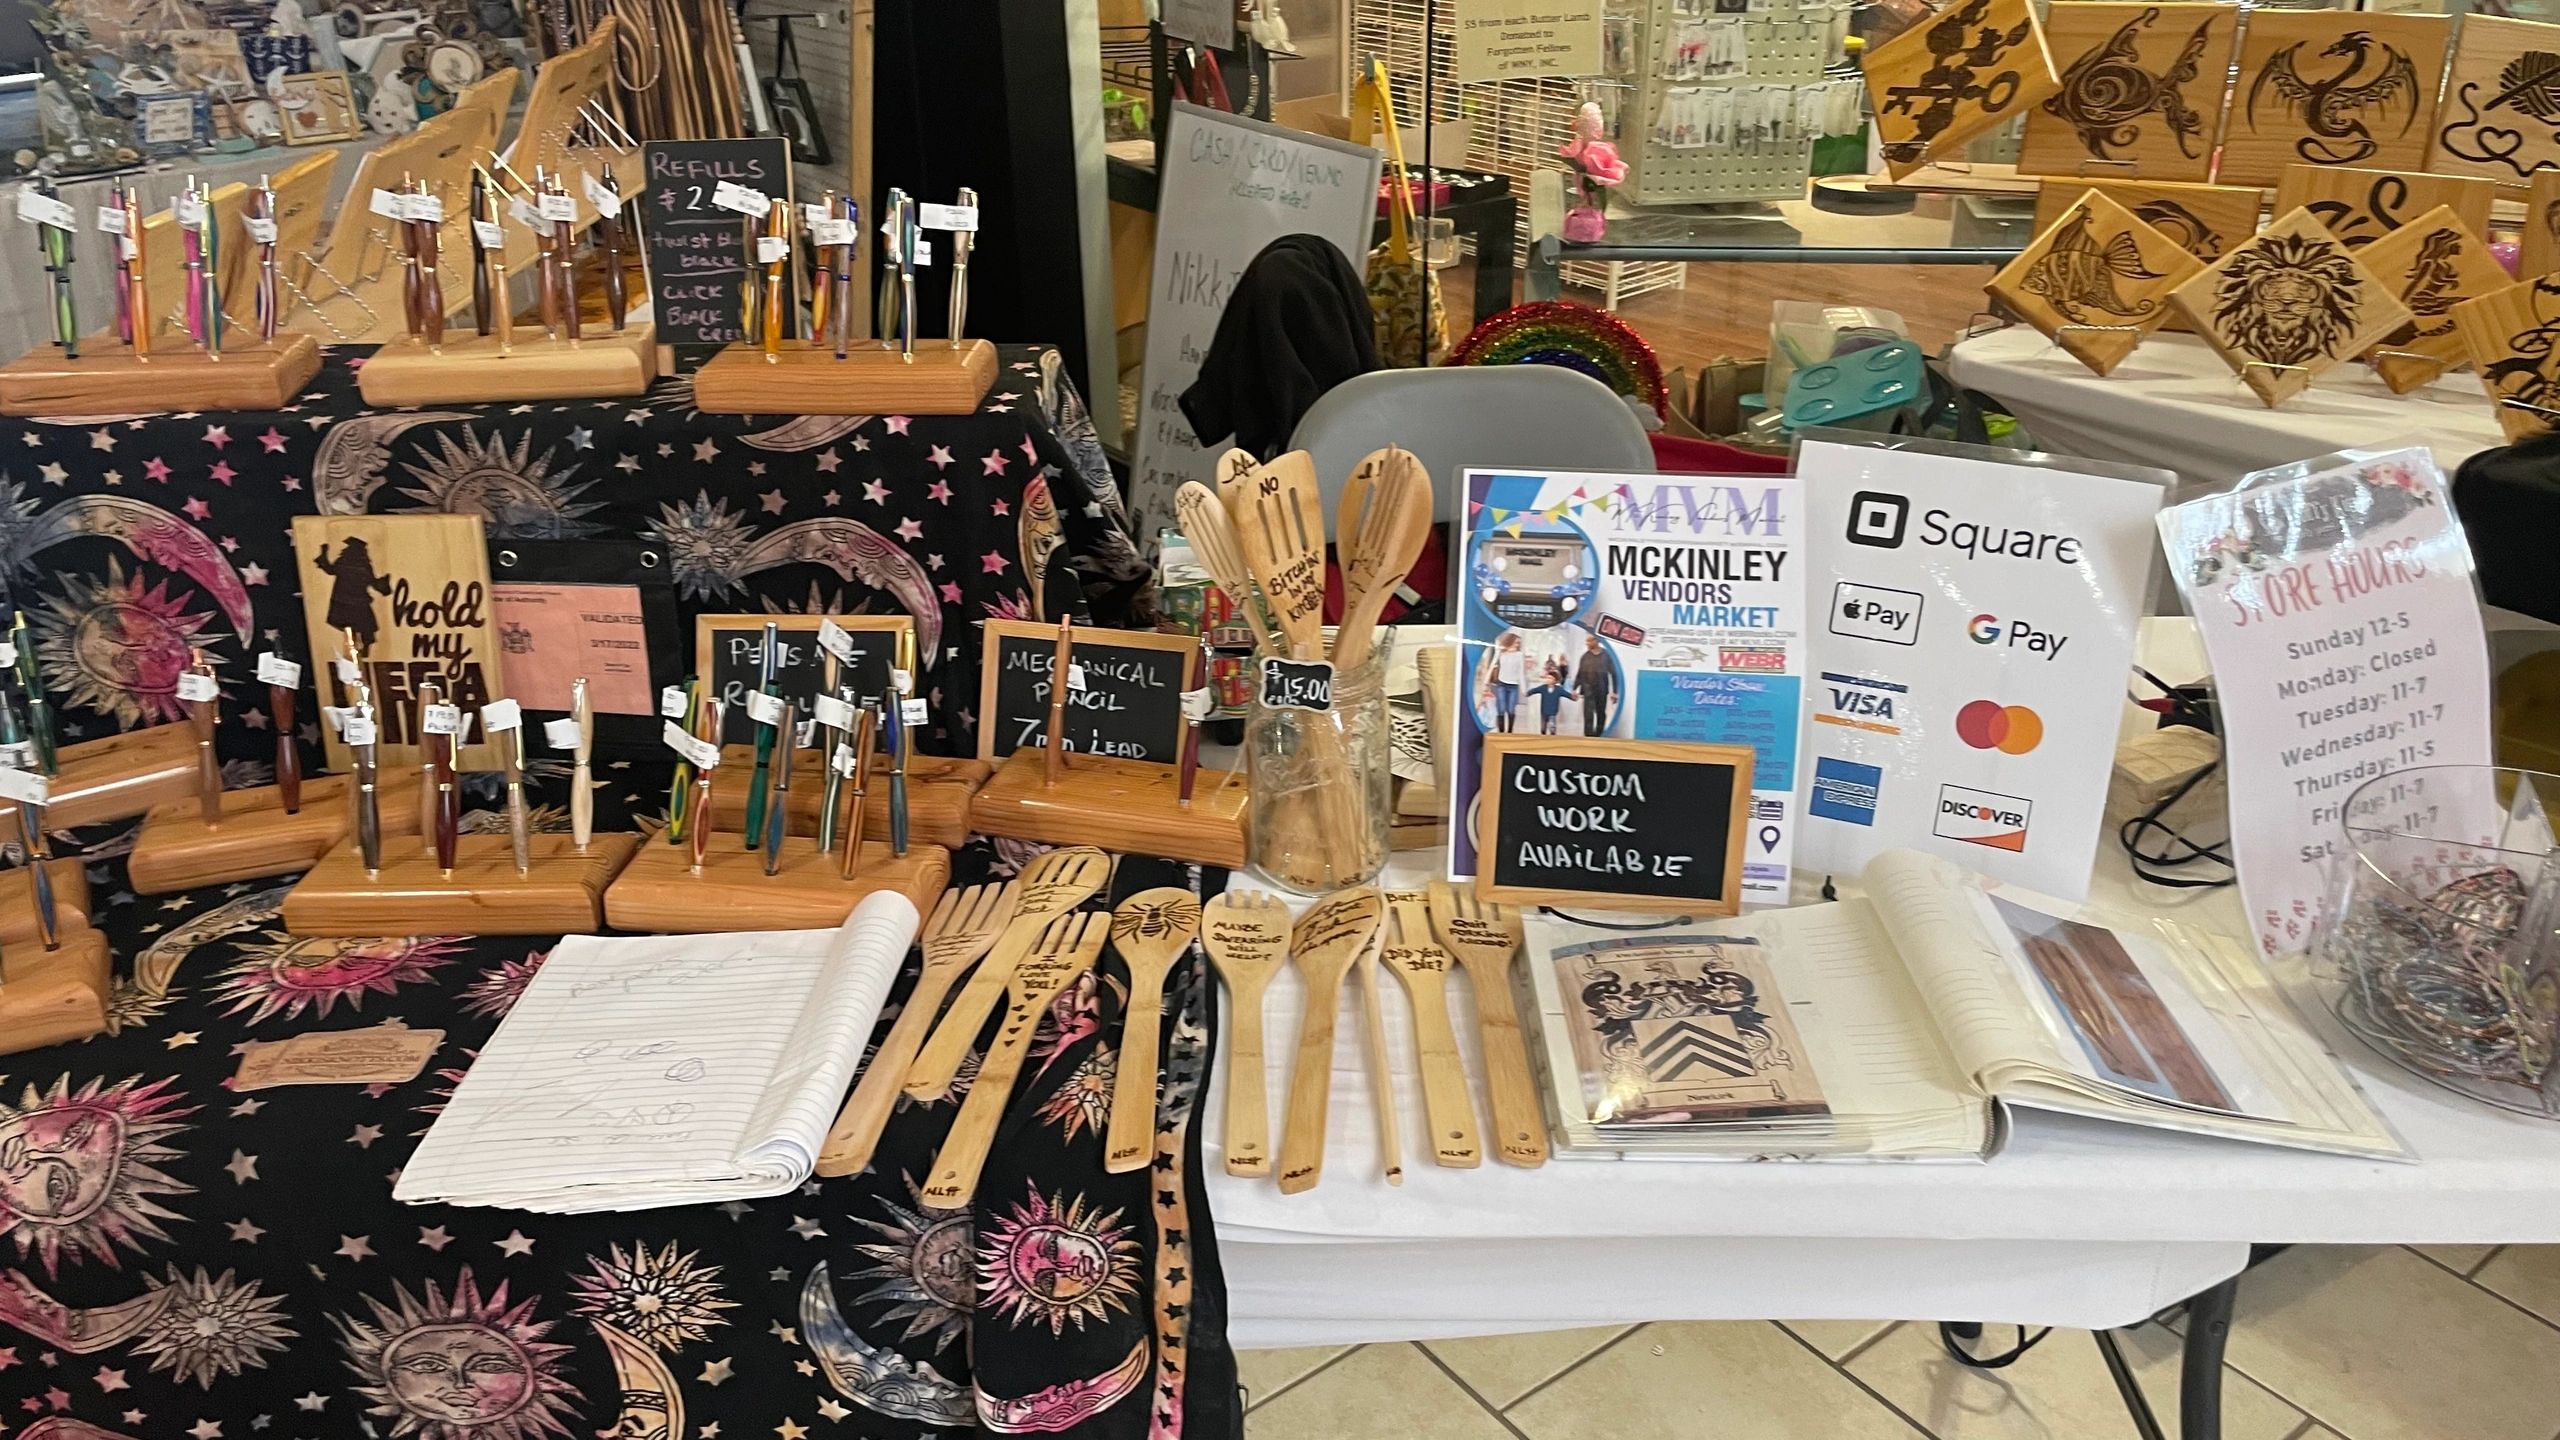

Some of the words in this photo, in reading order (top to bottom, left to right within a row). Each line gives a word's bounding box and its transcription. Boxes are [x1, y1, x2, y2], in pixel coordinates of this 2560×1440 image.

[1479, 18, 1502, 27] from
[1530, 14, 1562, 24] Butter
[1564, 13, 1592, 22] Lamb
[1500, 31, 1542, 40] Donated
[1486, 46, 1534, 57] Forgotten
[1536, 44, 1572, 53] Felines
[650, 152, 766, 181] REFILLS
[1258, 476, 1279, 497] NO
[1612, 483, 1782, 536] MVM
[1920, 509, 2083, 565] Square
[1608, 545, 1788, 582] MCKINLEY
[393, 578, 486, 628] hold
[1622, 579, 1732, 605] VENDORS
[580, 613, 644, 624] VALIDATED
[1673, 604, 1779, 628] MARKET
[1864, 602, 1910, 630] Pay
[2008, 620, 2069, 660] Pay
[2287, 626, 2366, 660] Sunday
[2368, 611, 2410, 639] 12-5
[412, 632, 472, 678] my
[1719, 652, 1787, 668] WEBR
[2278, 664, 2366, 700] Monday:
[2370, 638, 2437, 673] Closed
[1032, 682, 1126, 712] PNCIL
[1827, 688, 1894, 719] VISA
[2297, 693, 2387, 729] Tuesday:
[2391, 676, 2428, 701] 11-7
[1089, 728, 1148, 759] LEAD
[2281, 719, 2405, 768] Wednesday:
[2409, 704, 2445, 729] 11-7
[2294, 757, 2396, 798] Thursday:
[2400, 740, 2435, 765] 11-5
[1514, 765, 1647, 803] CUSTOM
[1813, 776, 1876, 796] AMERICAN
[2390, 778, 2426, 802] 11-7
[1824, 790, 1877, 810] EXPRESS
[1941, 799, 2024, 828] DISCOVER
[1537, 805, 1638, 834] WORK
[1212, 921, 1265, 932] MAYBE
